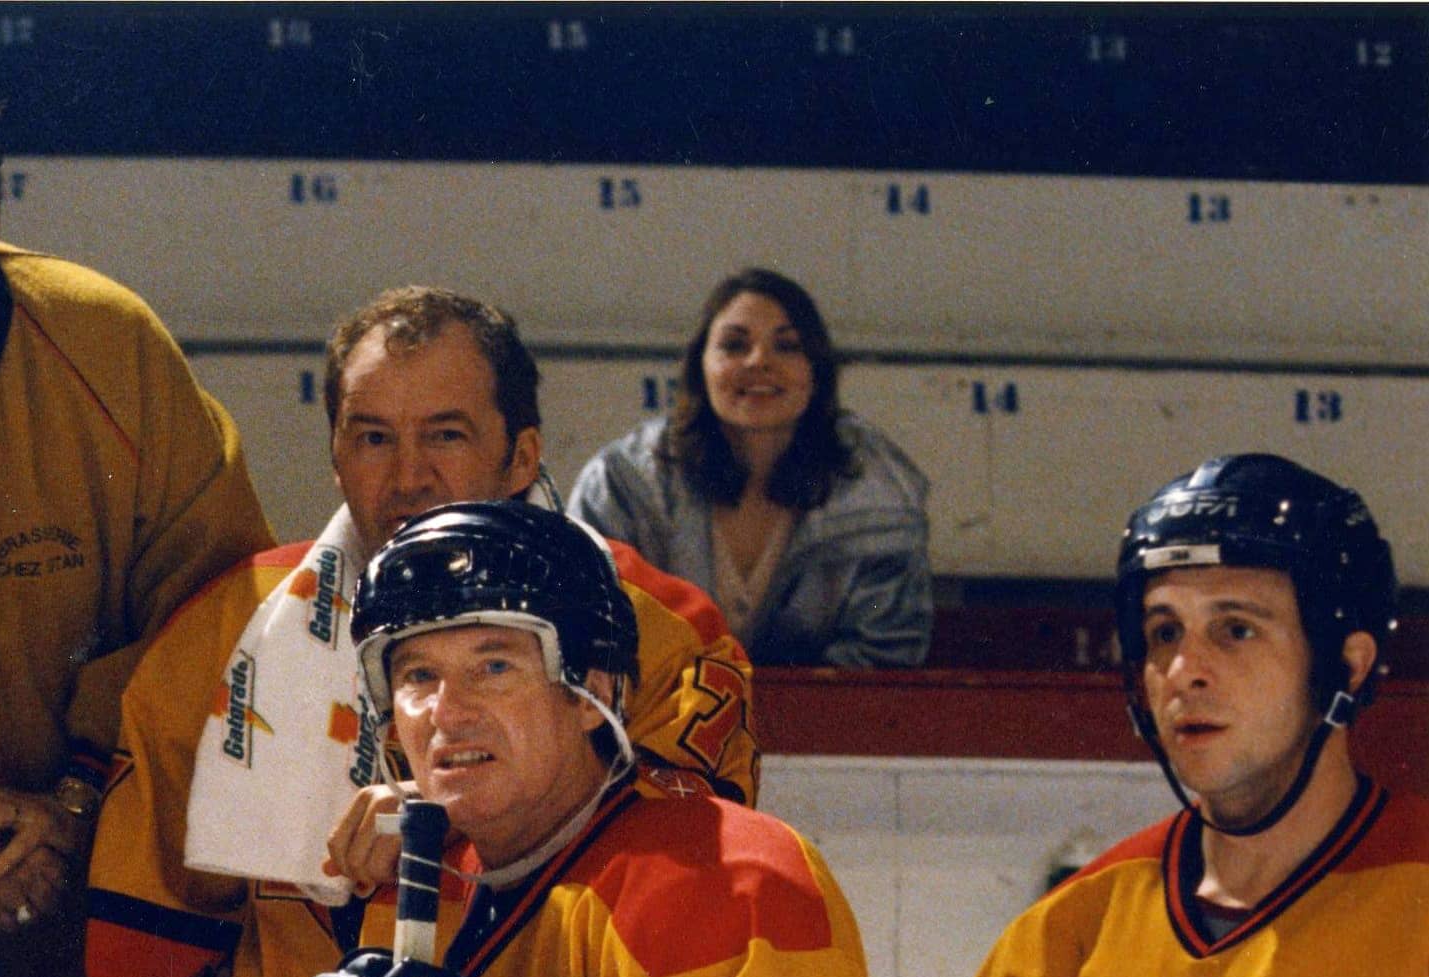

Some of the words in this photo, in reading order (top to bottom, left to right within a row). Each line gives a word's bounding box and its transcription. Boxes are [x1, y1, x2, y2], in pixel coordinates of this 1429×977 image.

[289, 174, 338, 204] 16
[599, 178, 641, 208] 15
[886, 184, 931, 215] 14
[1187, 193, 1231, 223] 13
[973, 382, 1018, 414] 14
[1294, 390, 1342, 423] 13
[308, 549, 338, 643] Gatorade
[223, 659, 250, 762] Gatorade
